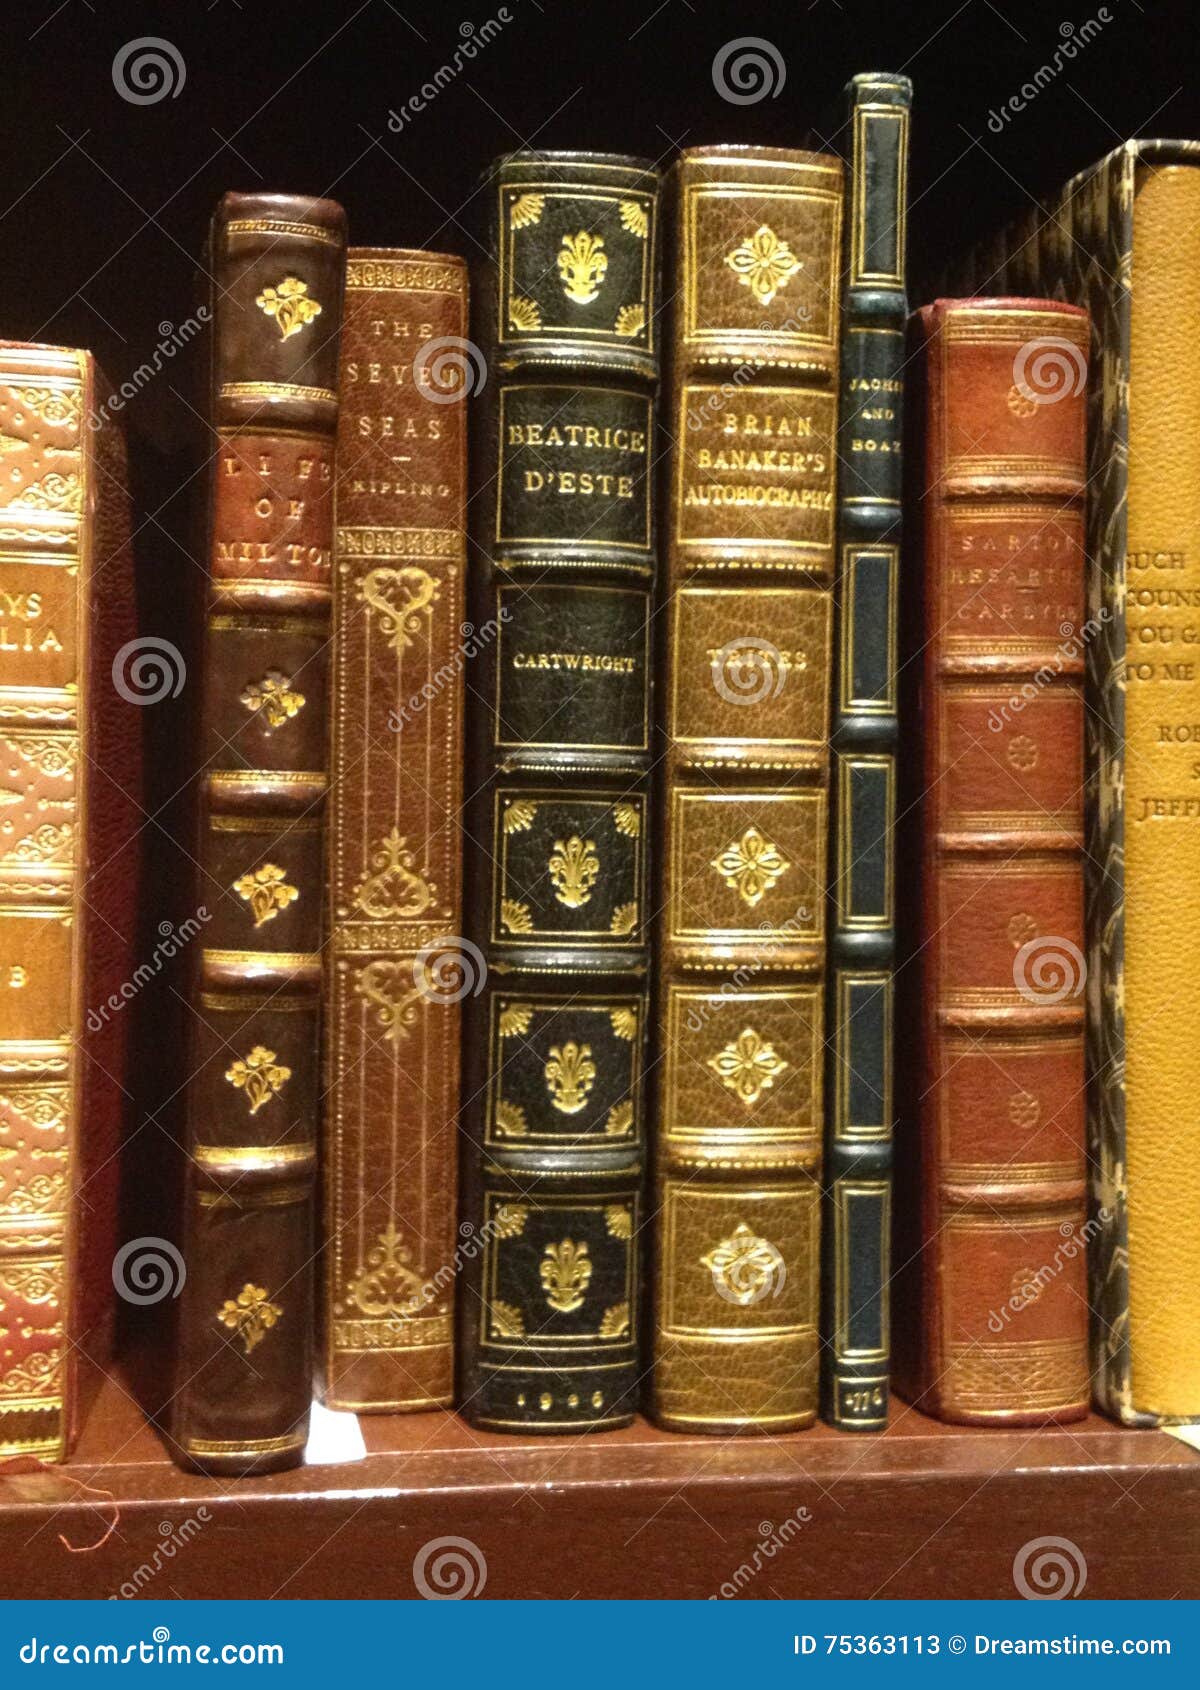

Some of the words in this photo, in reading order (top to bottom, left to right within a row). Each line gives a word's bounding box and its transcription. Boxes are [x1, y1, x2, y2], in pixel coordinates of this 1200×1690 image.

[370, 320, 433, 338] THE
[723, 413, 813, 437] BRIAN
[861, 408, 895, 420] AND
[359, 416, 441, 439] SEAS
[508, 424, 645, 453] BEATRICE
[698, 449, 825, 472] BANAKER'S
[353, 481, 450, 497] KIPLING
[524, 471, 633, 498] D'ESTE
[685, 486, 832, 510] AUTOBIOGRAPHY
[513, 654, 636, 672] CARTWRIGHT
[1160, 663, 1195, 680] ME
[1135, 798, 1200, 822] JEFF
